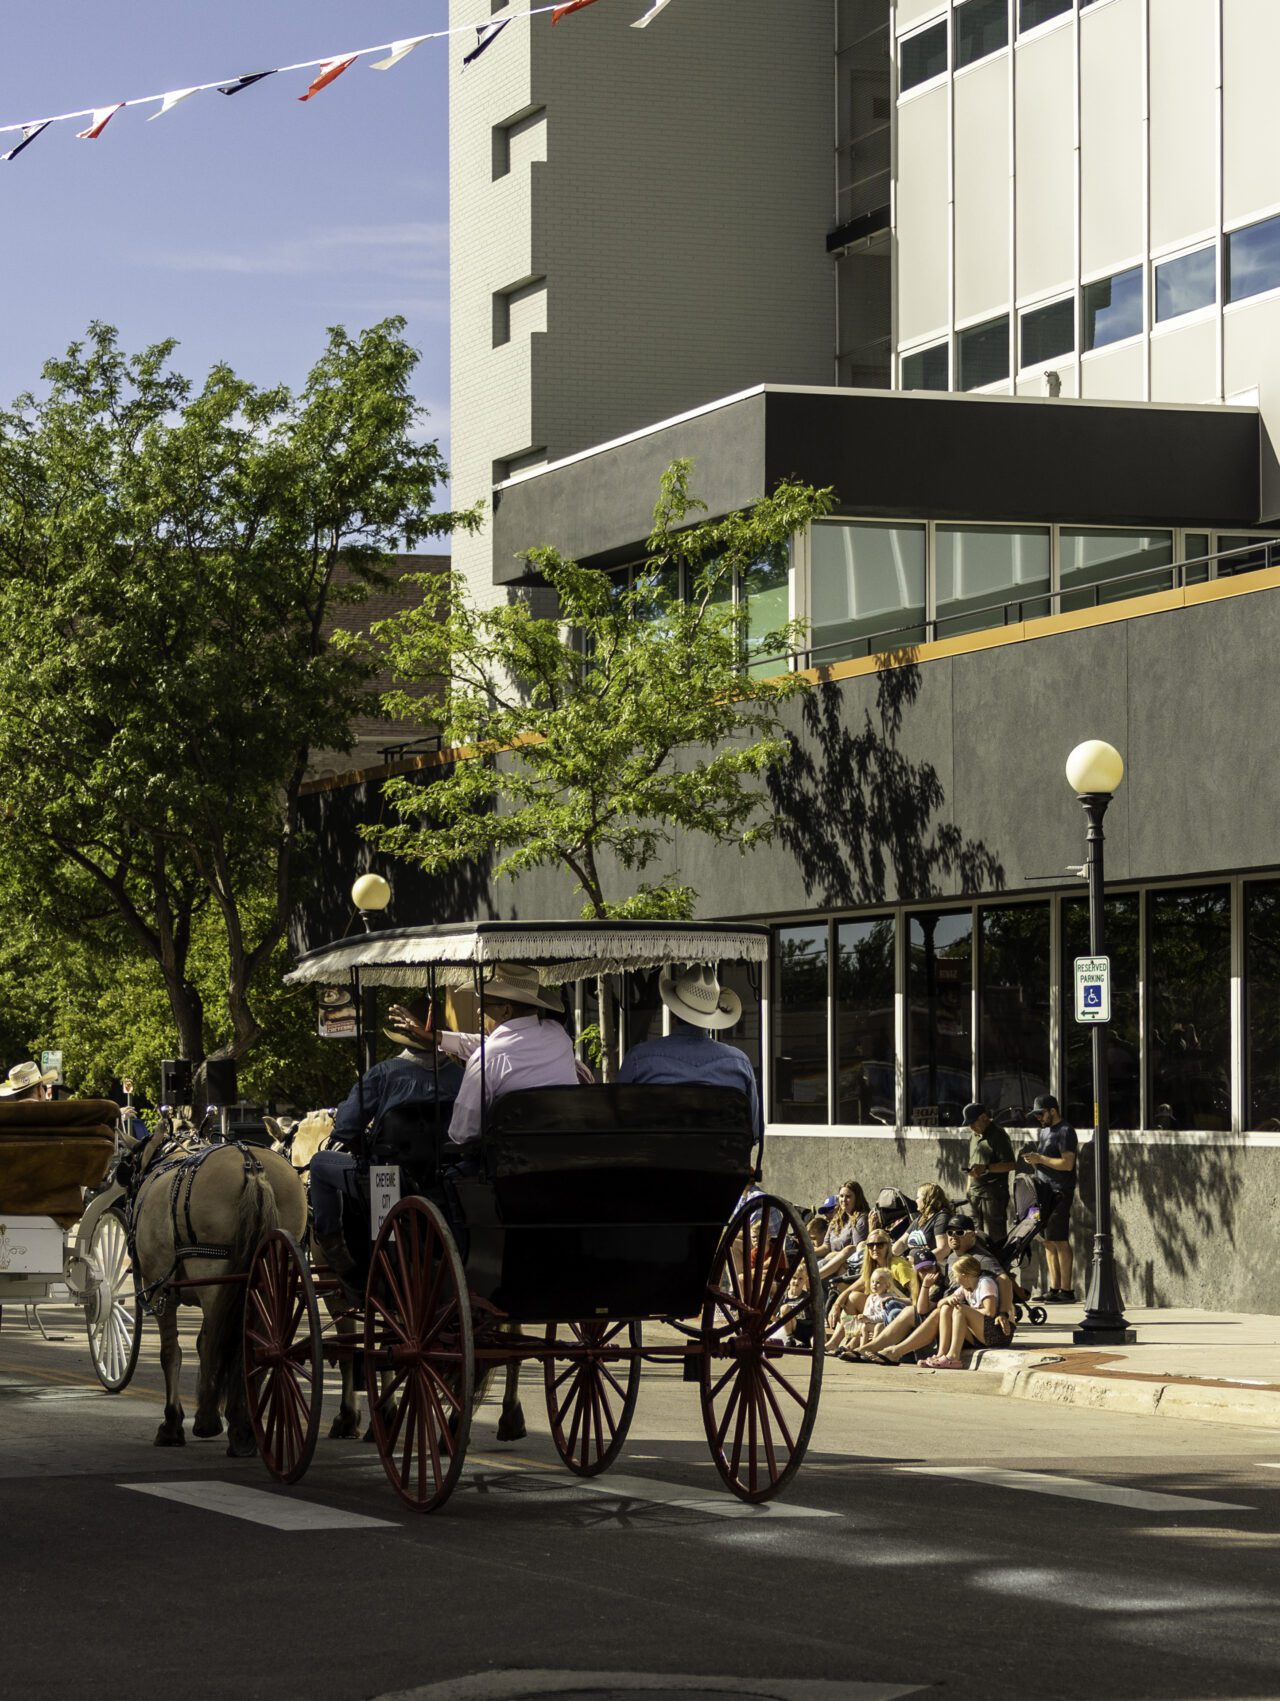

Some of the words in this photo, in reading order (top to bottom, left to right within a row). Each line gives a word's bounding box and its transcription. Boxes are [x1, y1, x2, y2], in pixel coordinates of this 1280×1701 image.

[1077, 963, 1107, 972] RESERVED
[1080, 974, 1105, 983] PARKING
[376, 1173, 396, 1188] CHEYENNE
